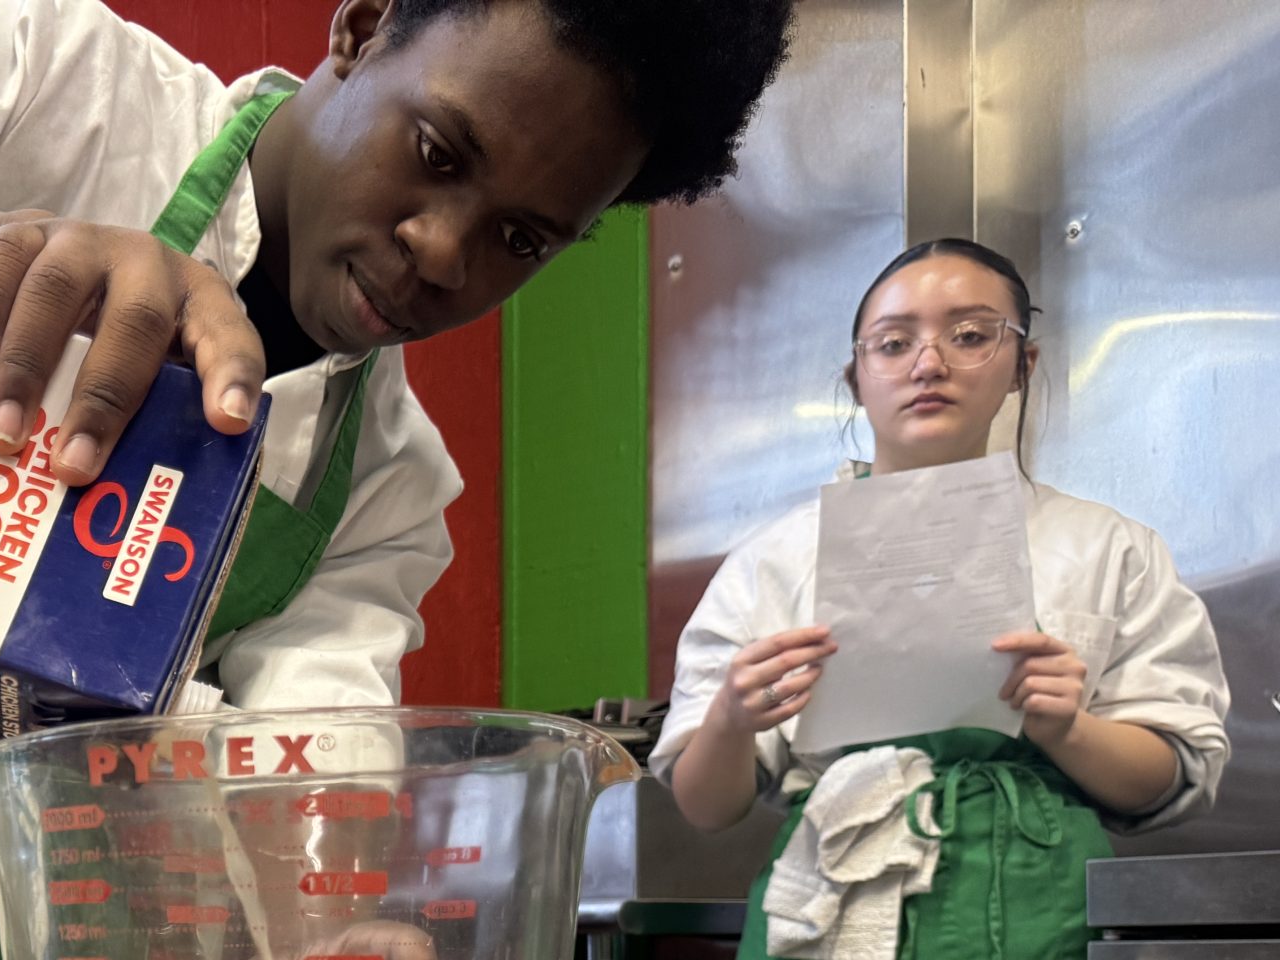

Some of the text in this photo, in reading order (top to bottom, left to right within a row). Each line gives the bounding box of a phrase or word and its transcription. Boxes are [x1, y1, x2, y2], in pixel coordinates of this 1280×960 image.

[112, 475, 174, 596] SWANSON
[0, 676, 20, 738] CHICKEN STO
[87, 734, 316, 788] PYREX
